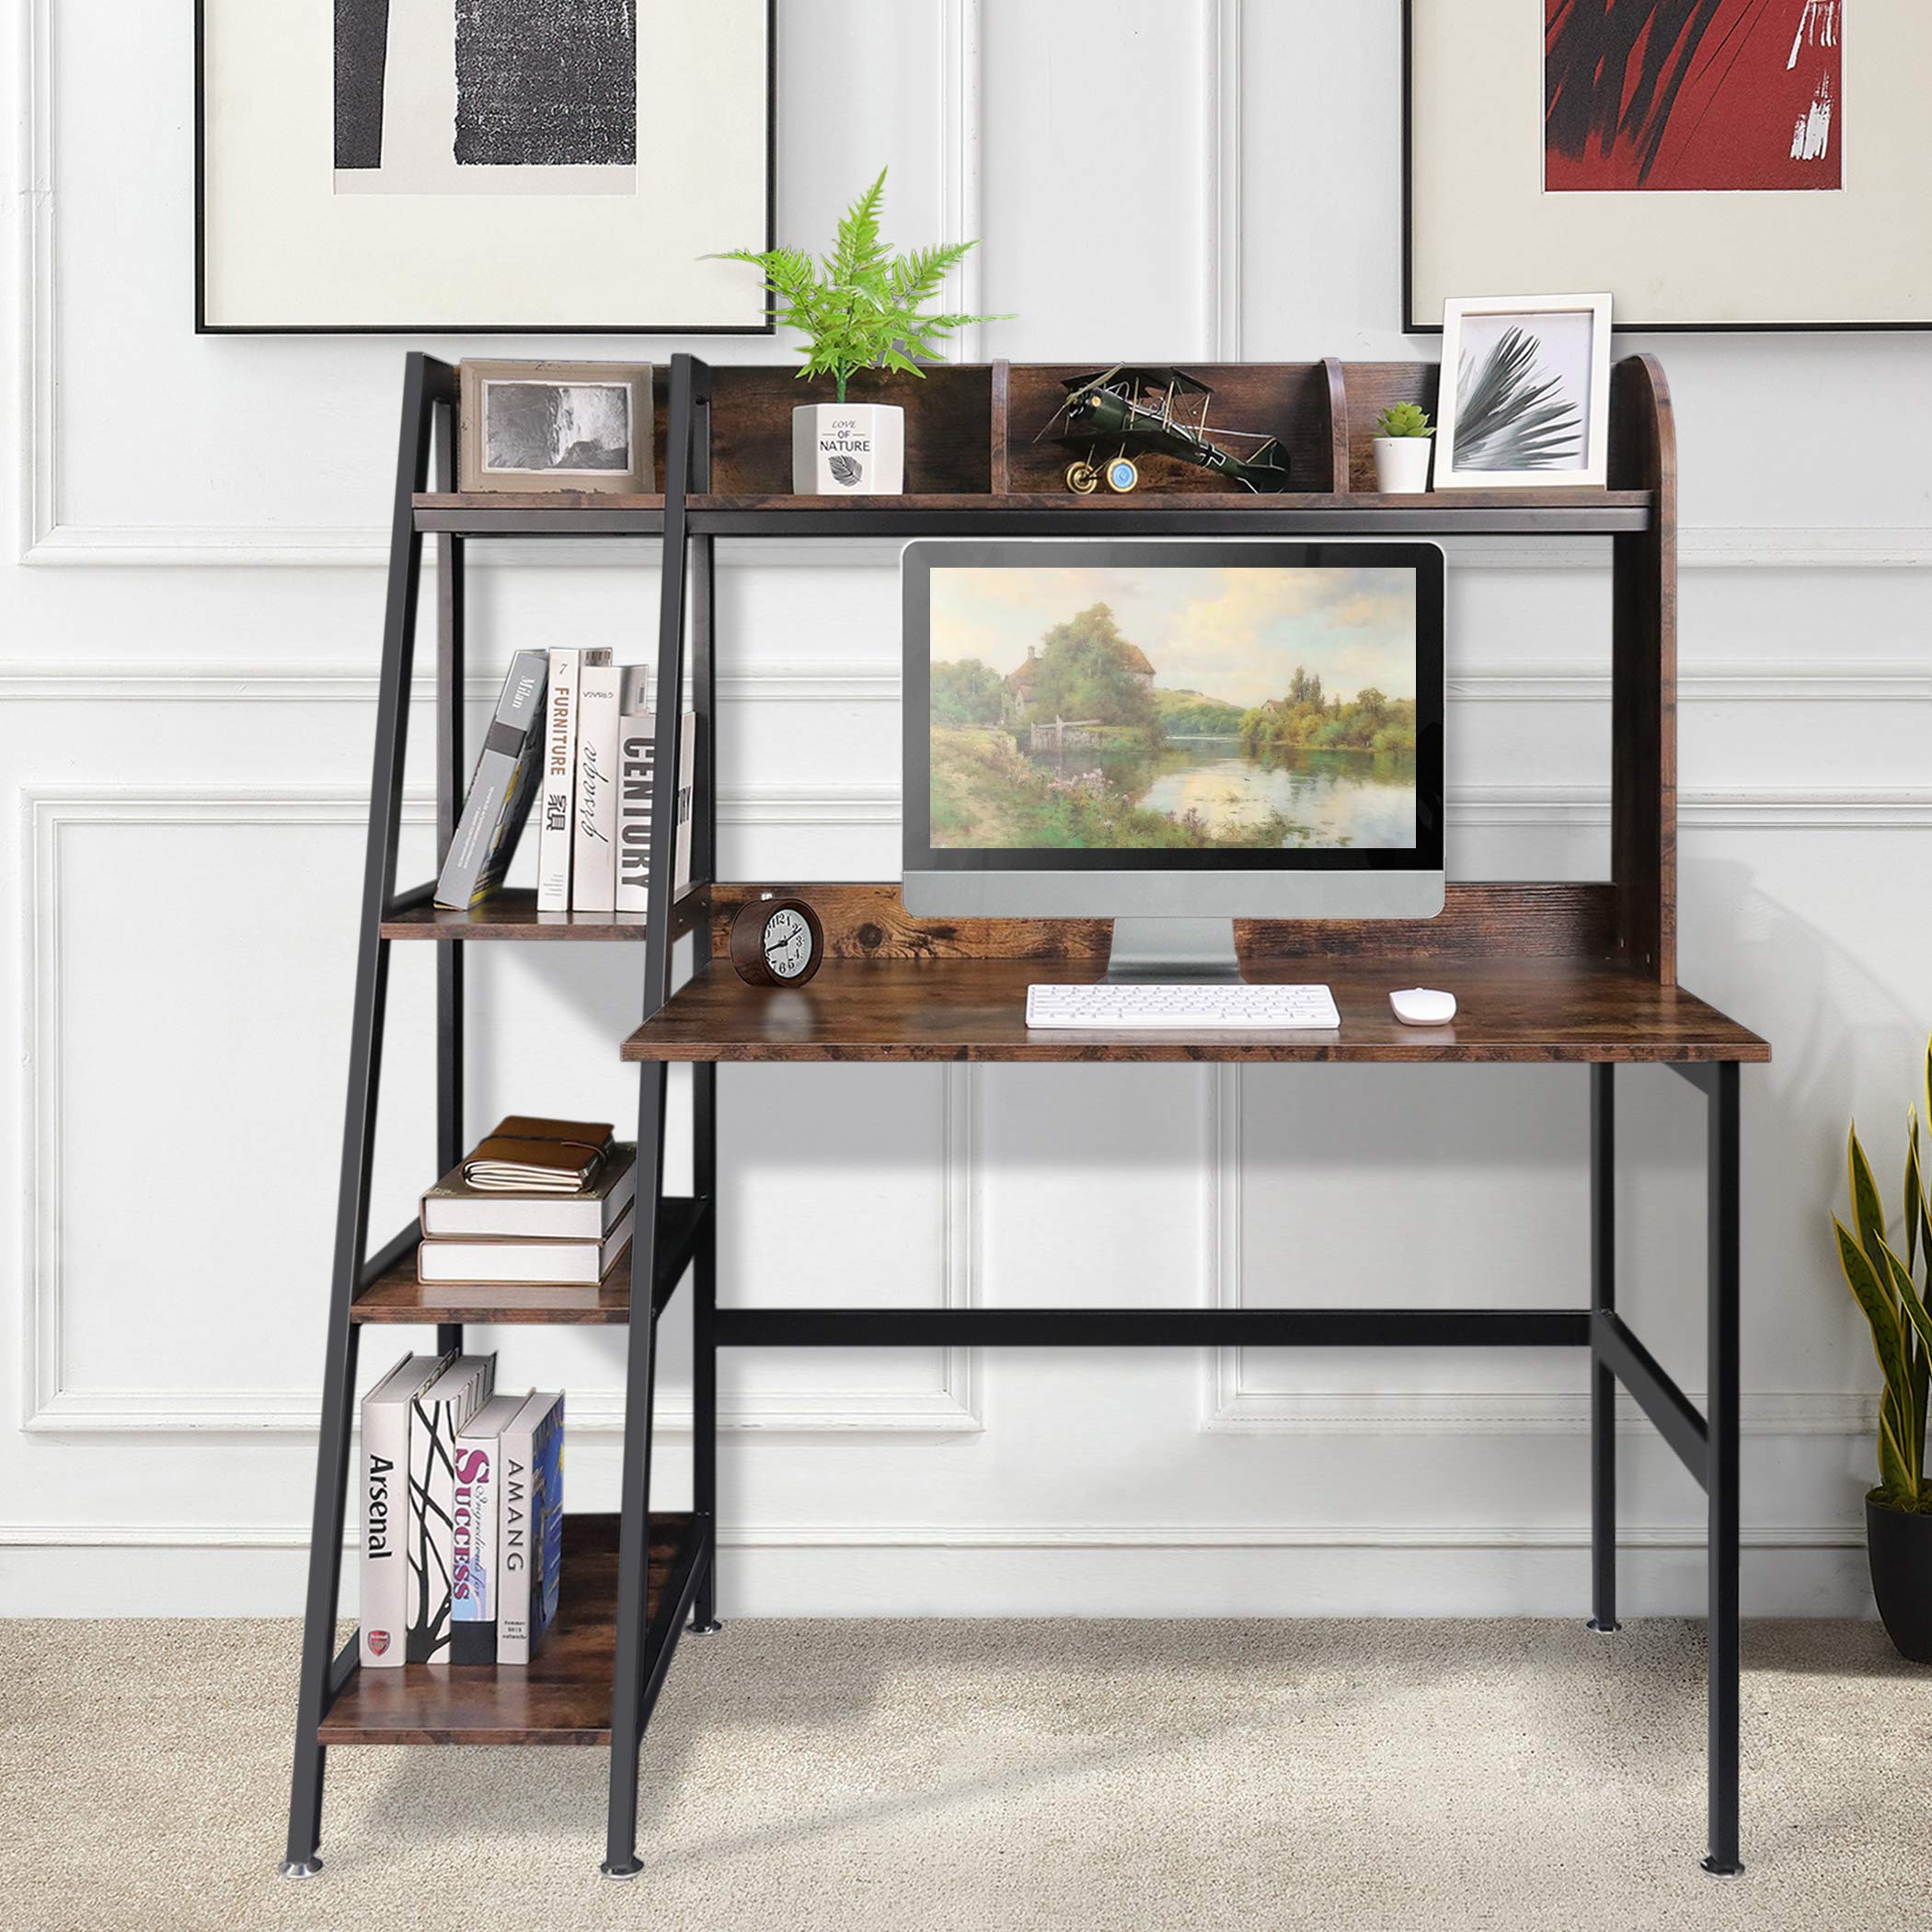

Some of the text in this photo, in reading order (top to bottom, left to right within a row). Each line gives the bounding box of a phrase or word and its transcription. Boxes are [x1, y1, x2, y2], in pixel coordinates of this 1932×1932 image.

[832, 420, 857, 429] LOVE
[837, 430, 851, 440] OF
[820, 441, 871, 453] NATURE
[512, 675, 535, 708] Milan
[549, 686, 570, 776] FURNITURE
[778, 961, 787, 974] 6
[368, 1455, 395, 1560] Arsenal
[507, 1458, 525, 1572] AMANG
[467, 1574, 484, 1598] for
